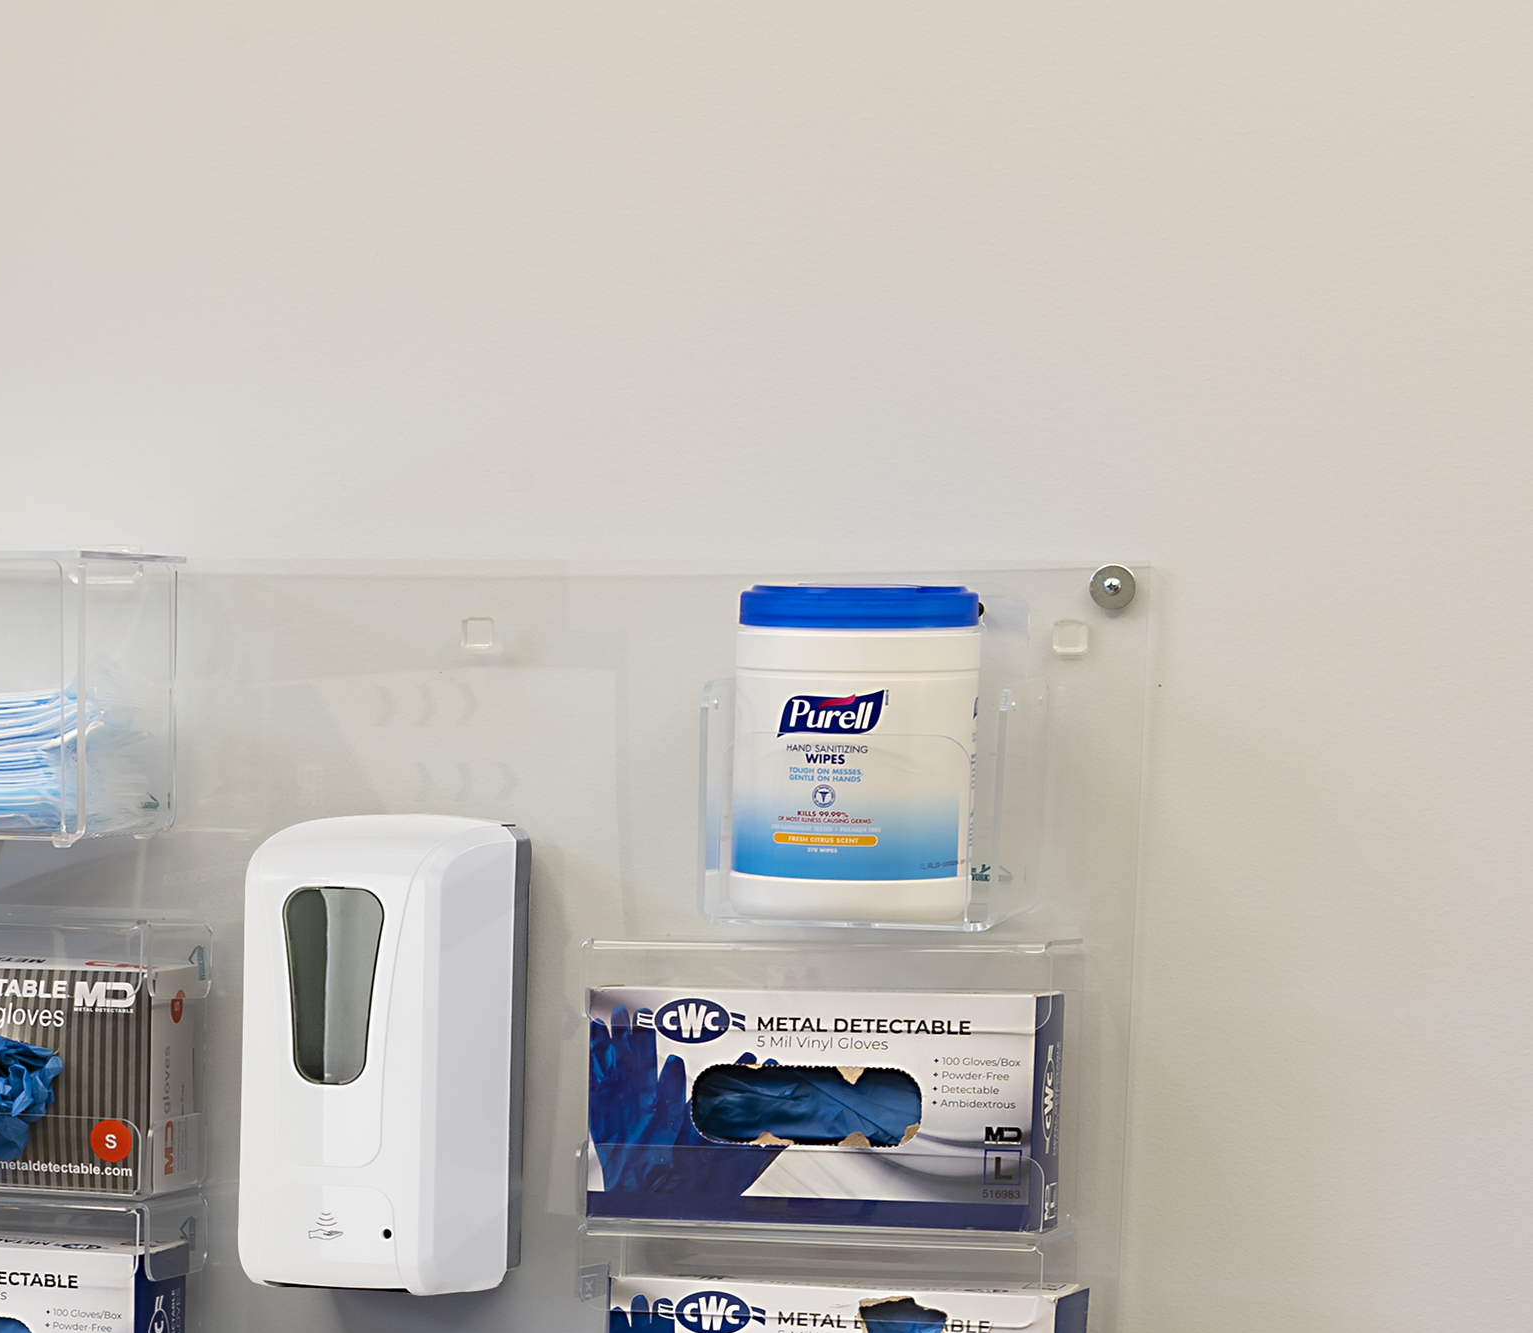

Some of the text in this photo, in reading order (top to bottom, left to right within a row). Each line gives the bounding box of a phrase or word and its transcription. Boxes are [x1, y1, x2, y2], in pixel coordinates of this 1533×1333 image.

[789, 699, 874, 729] Purell
[786, 744, 868, 754] HAND SANITIZING
[805, 753, 845, 765] WIPES
[788, 766, 815, 774] TOUGH
[817, 767, 830, 775] ON
[789, 774, 815, 782] GENTLE
[832, 775, 862, 783] HANDS
[74, 980, 137, 1008] MD
[757, 1016, 972, 1035] METAL DETECTABLE
[756, 1036, 889, 1051] 5 Mil Vinyl Gloves
[942, 1057, 1021, 1068] 100 Gloves/Box
[942, 1071, 1010, 1081] Powder-Free
[941, 1085, 1000, 1095] Detectable
[940, 1099, 1016, 1110] Ambidextrous
[985, 1126, 1022, 1142] MD
[104, 1134, 118, 1150] S
[994, 1156, 1013, 1180] L
[982, 1189, 1021, 1200] 516983
[52, 1308, 123, 1320] 100 Gloves/Box
[777, 1310, 847, 1329] METAL
[52, 1321, 113, 1333] Powder-Free
